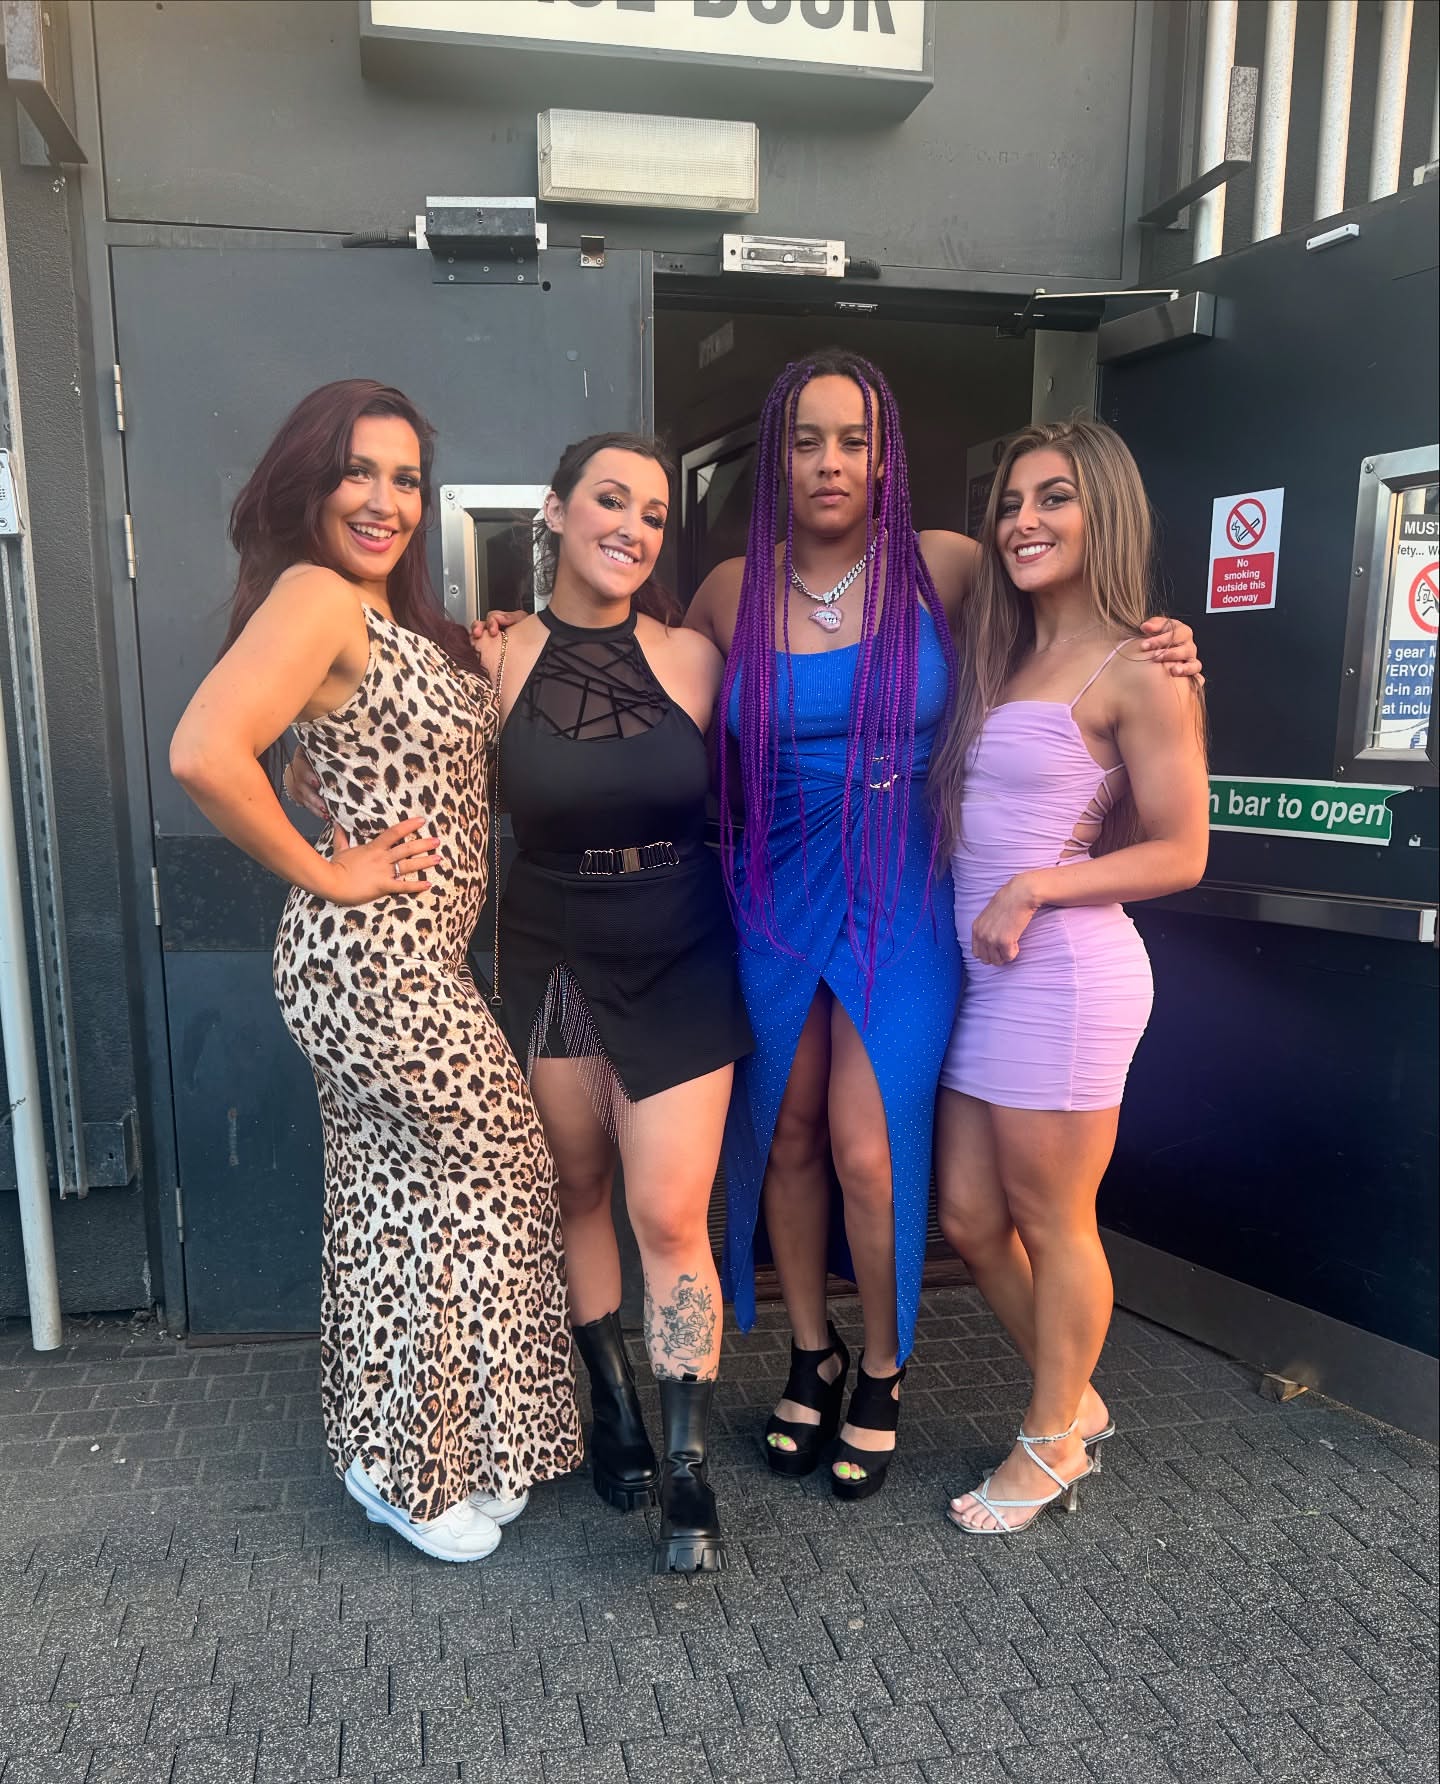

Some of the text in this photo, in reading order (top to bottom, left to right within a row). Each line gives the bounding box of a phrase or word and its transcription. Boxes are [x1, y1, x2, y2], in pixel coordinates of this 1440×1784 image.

[1236, 558, 1249, 568] No
[1224, 569, 1260, 580] smoking
[1216, 580, 1266, 593] outside this
[1222, 593, 1259, 604] doorway
[1395, 648, 1425, 661] gear
[1385, 682, 1433, 696] d-in an
[1382, 702, 1396, 715] at
[1228, 788, 1271, 817] bar
[1277, 792, 1303, 819] to
[1310, 799, 1386, 830] open
